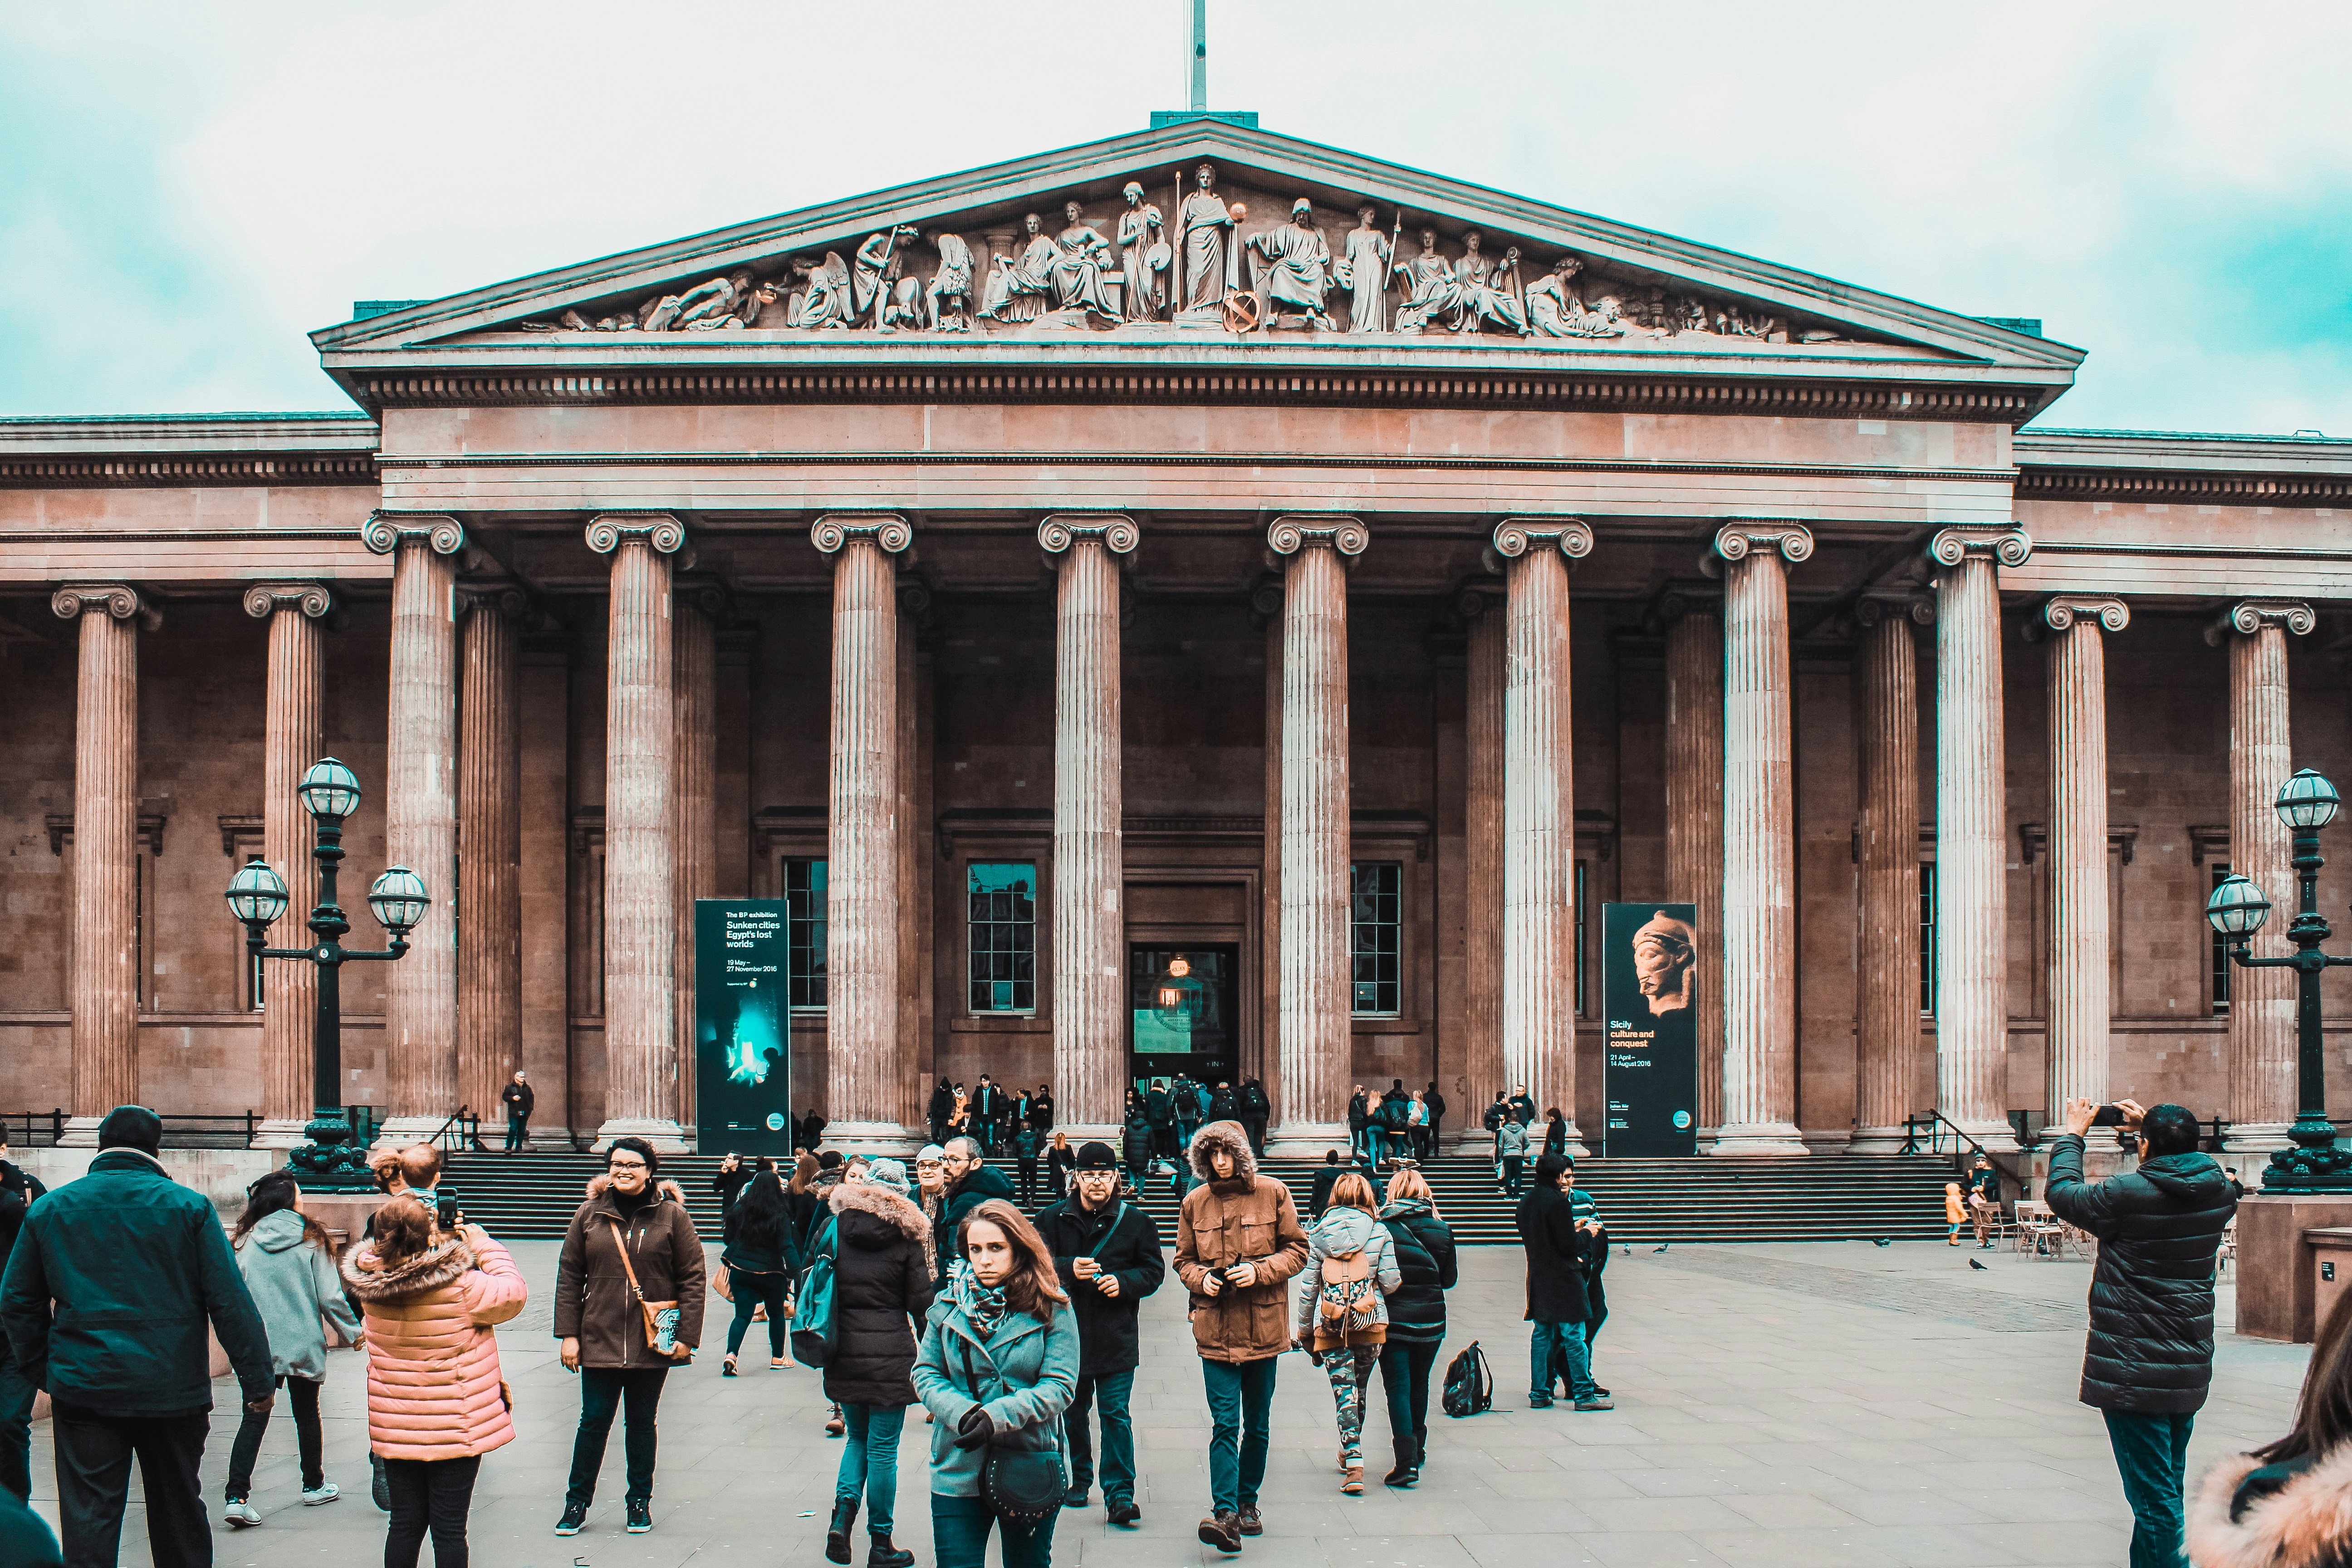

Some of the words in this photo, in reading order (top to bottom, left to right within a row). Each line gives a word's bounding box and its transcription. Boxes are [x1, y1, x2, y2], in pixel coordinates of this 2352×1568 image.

[726, 931, 755, 940] Egypt's
[1610, 1020, 1632, 1029] Sicily
[1610, 1039, 1648, 1048] conquest
